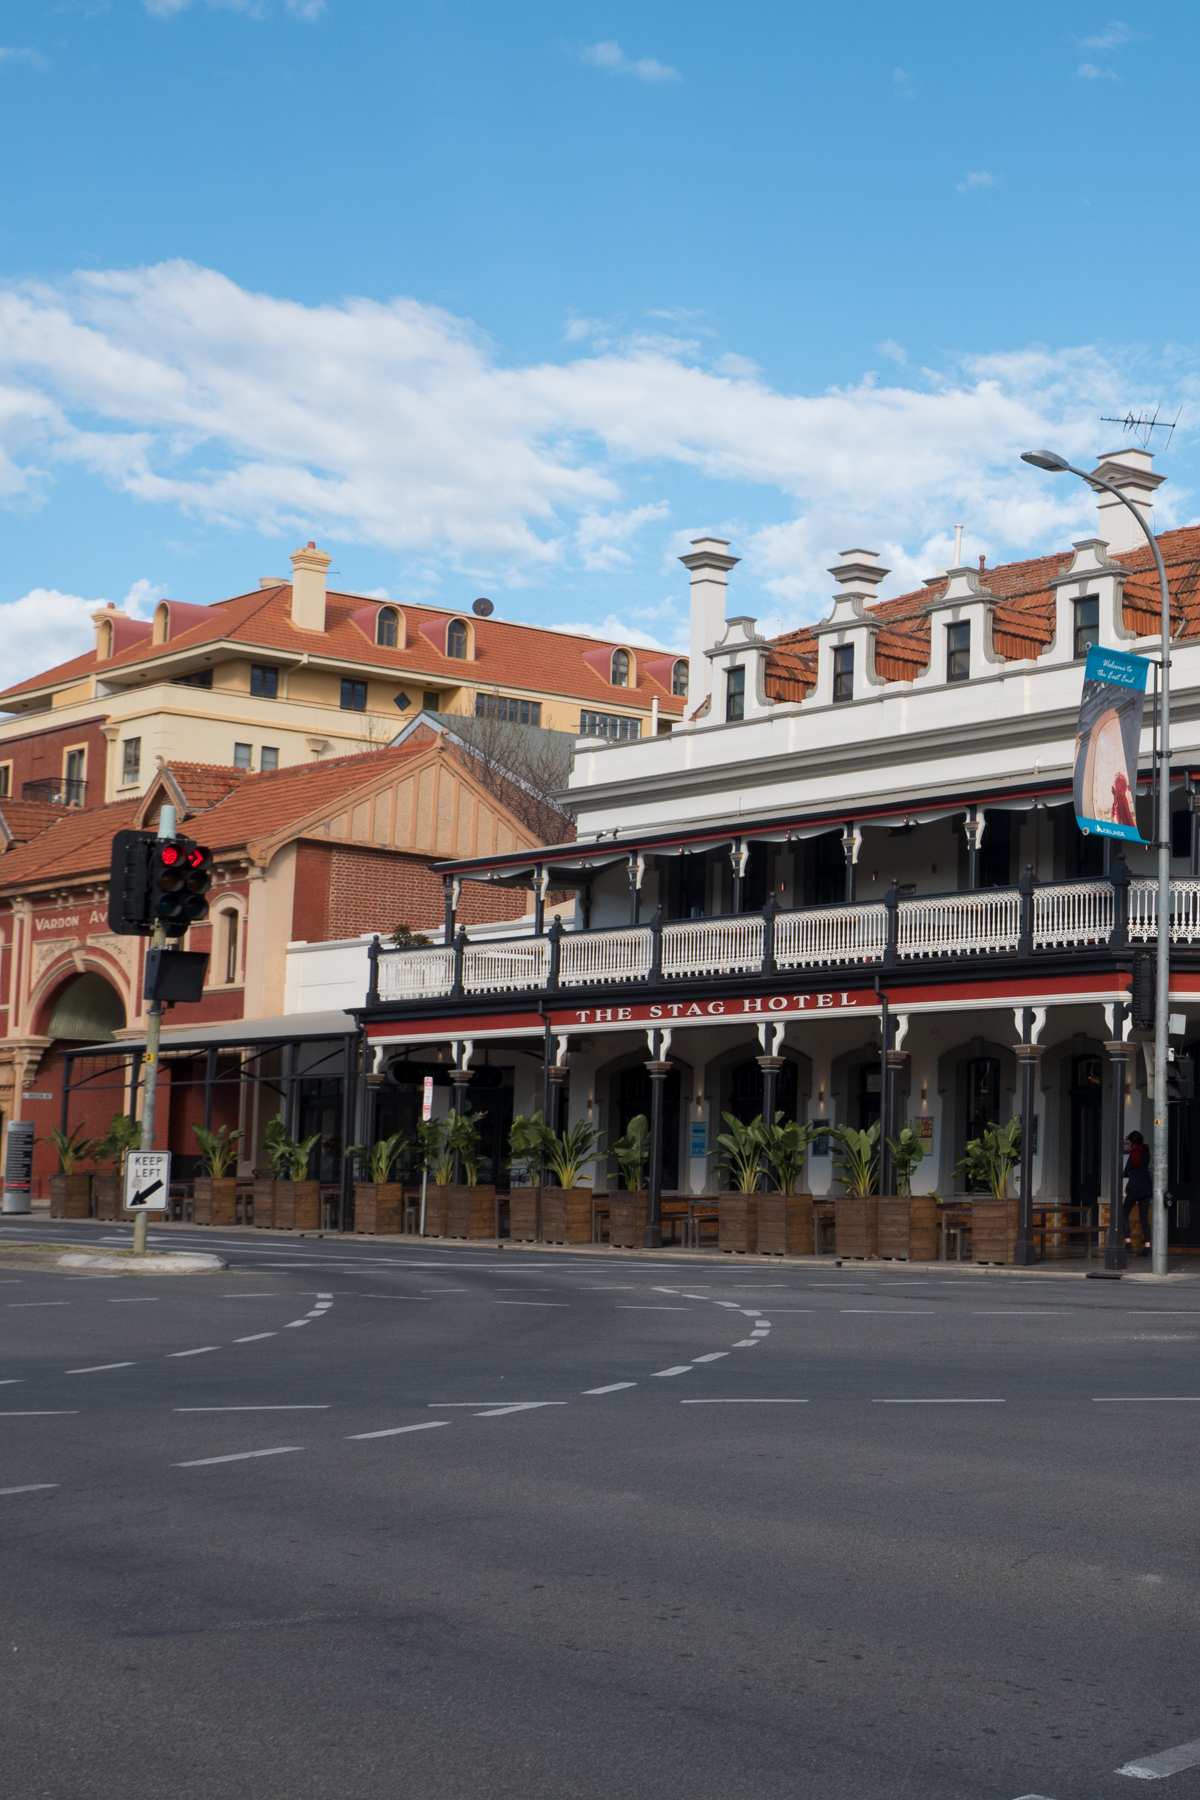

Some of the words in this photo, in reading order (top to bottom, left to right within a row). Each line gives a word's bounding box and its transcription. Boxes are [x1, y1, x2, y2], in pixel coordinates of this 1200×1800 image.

[35, 915, 79, 931] VARDON
[575, 1007, 632, 1023] THE
[650, 1001, 726, 1017] STAG
[743, 992, 857, 1013] HOTEL
[135, 1156, 163, 1166] KEEP
[135, 1168, 161, 1178] LEFT
